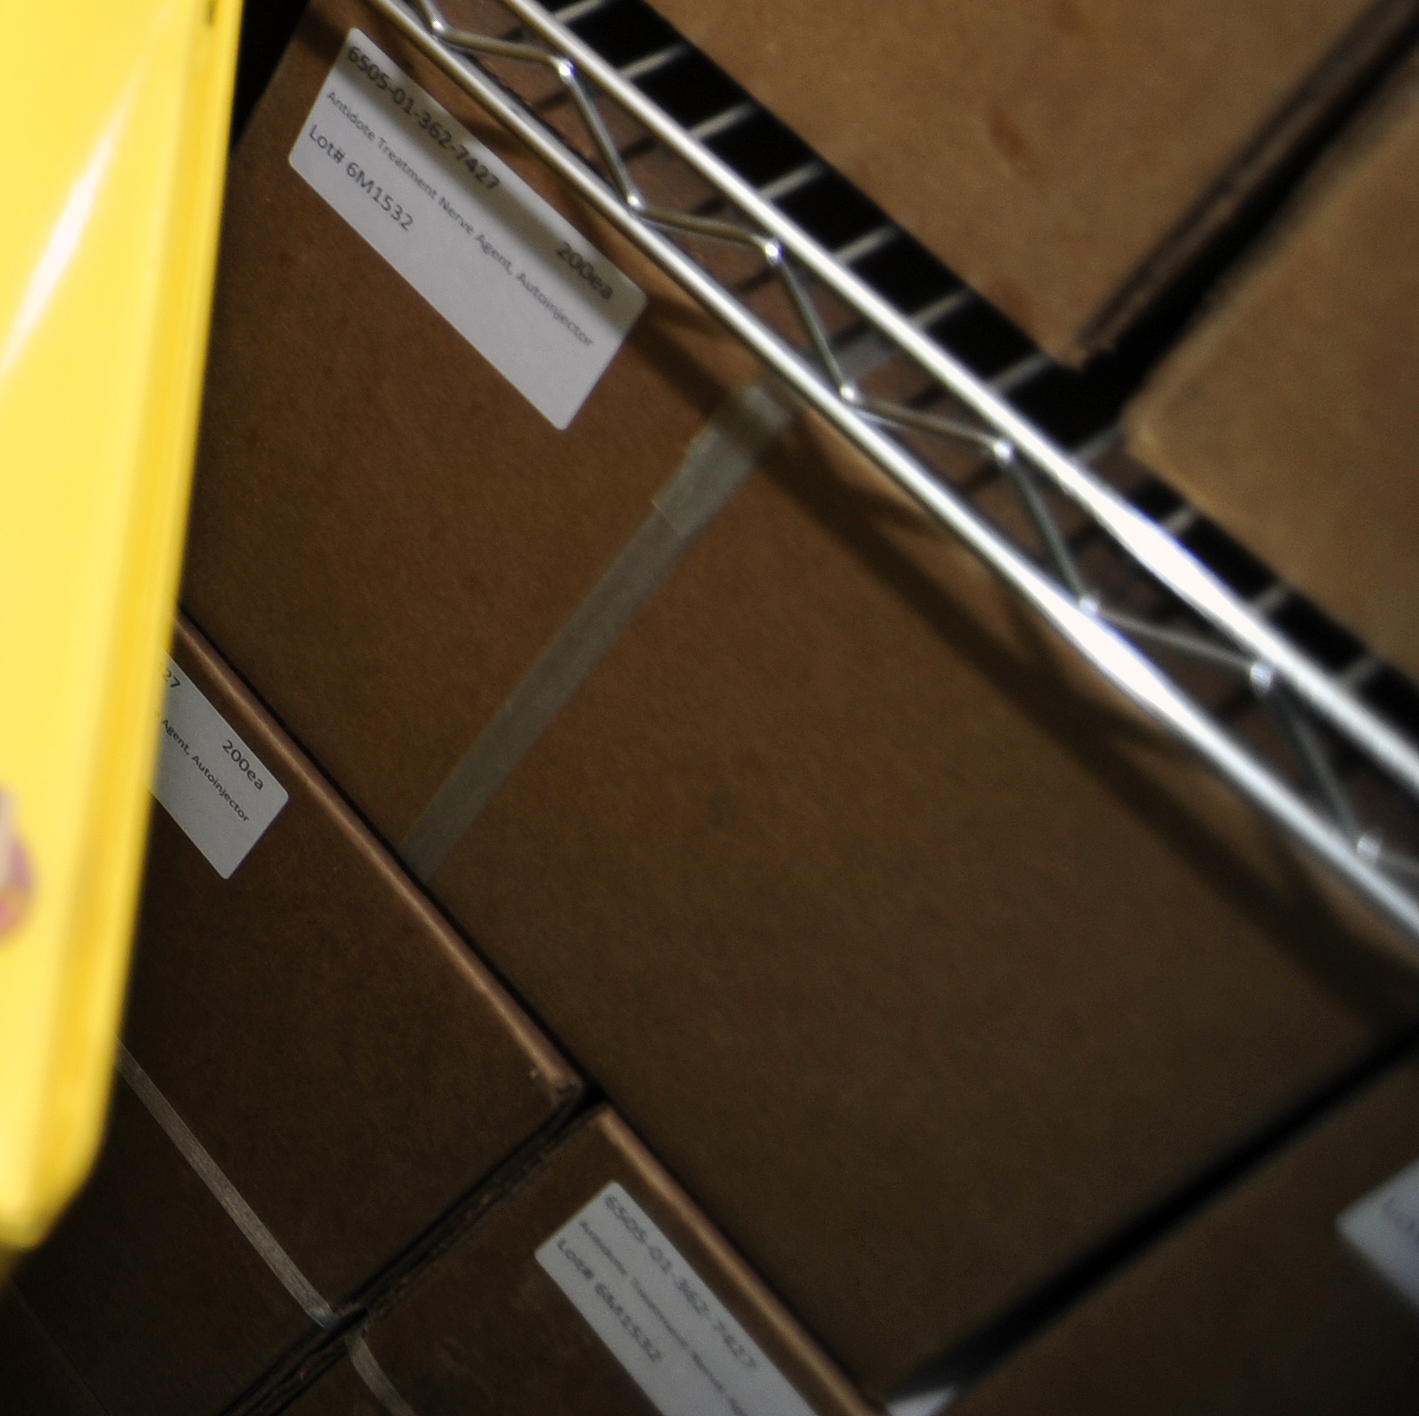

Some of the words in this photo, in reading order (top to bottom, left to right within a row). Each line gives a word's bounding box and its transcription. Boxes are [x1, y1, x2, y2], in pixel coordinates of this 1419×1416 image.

[308, 124, 347, 166] Lot#
[346, 161, 415, 233] 6M1532
[326, 90, 377, 144] Antidote
[376, 135, 440, 204] Treatment
[437, 195, 477, 237] Nerve
[516, 271, 594, 349] Autoinjector
[347, 46, 501, 192] 6505-01-362-7427
[556, 239, 613, 302] 200ea
[191, 754, 250, 823] Autoinjector
[222, 739, 264, 792] 200ea
